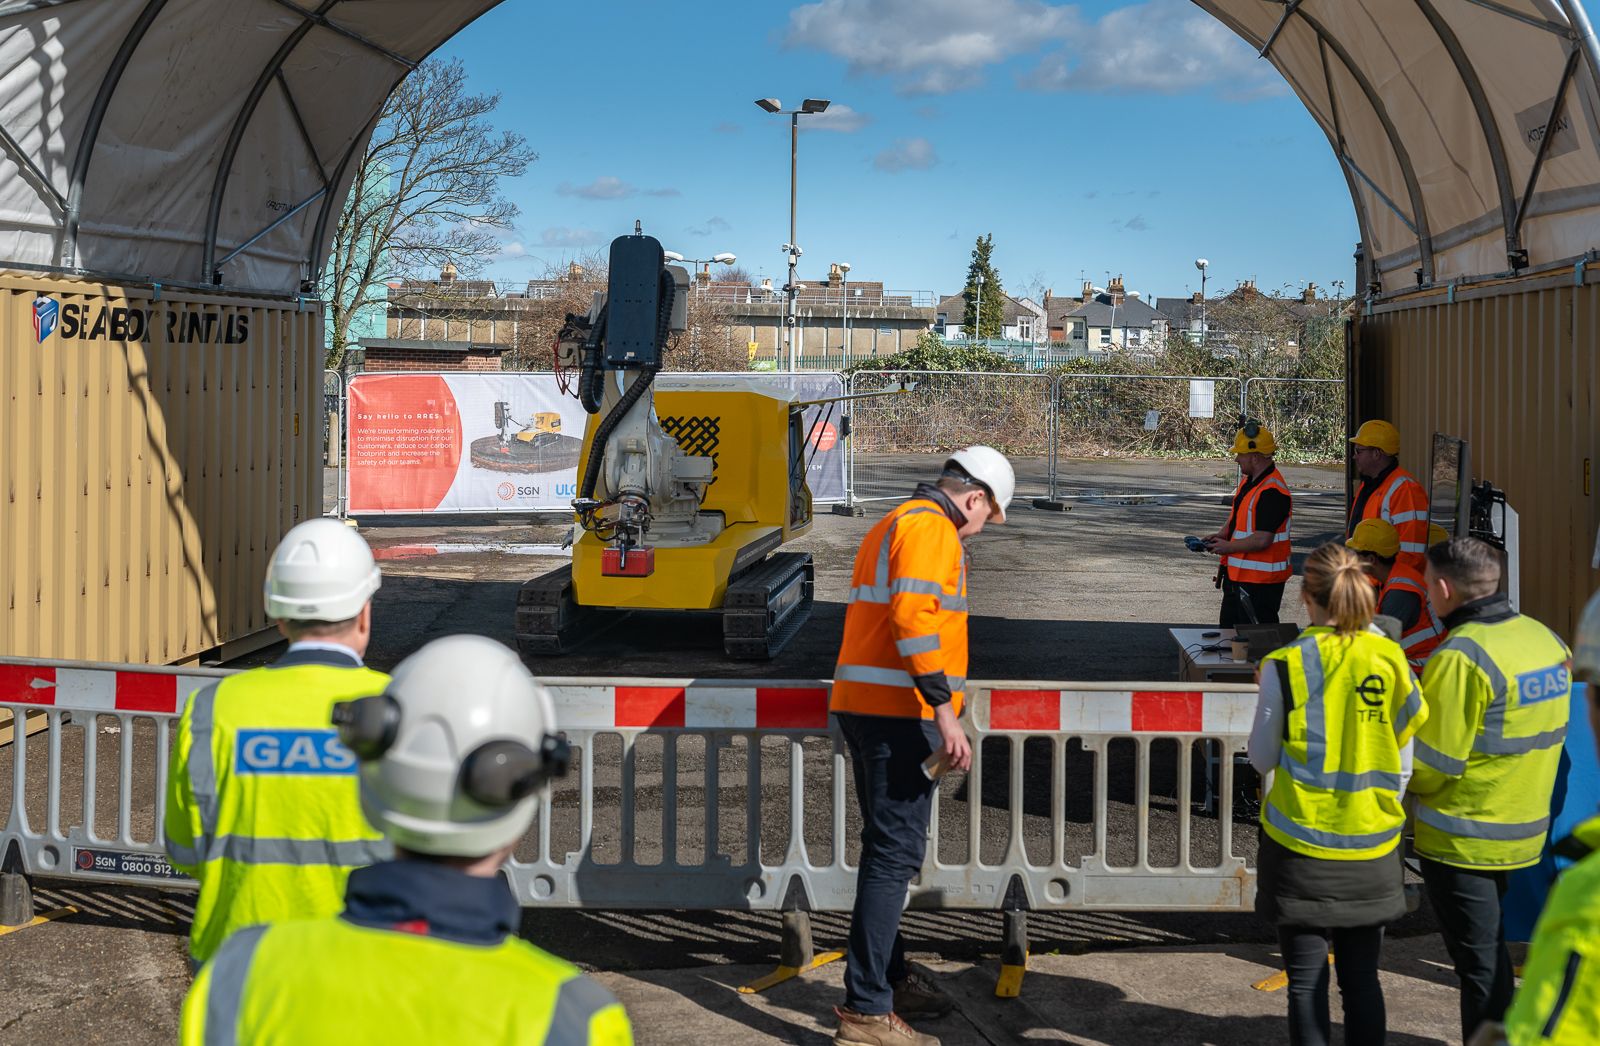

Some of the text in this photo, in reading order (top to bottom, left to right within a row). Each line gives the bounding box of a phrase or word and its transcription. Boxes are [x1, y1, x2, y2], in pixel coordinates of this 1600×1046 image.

[517, 486, 540, 496] SGN
[1522, 668, 1568, 699] GAS
[1357, 709, 1388, 724] TFL
[243, 735, 356, 769] GAS
[95, 856, 116, 867] SGN
[121, 861, 151, 873] 0800
[154, 864, 172, 875] 912
